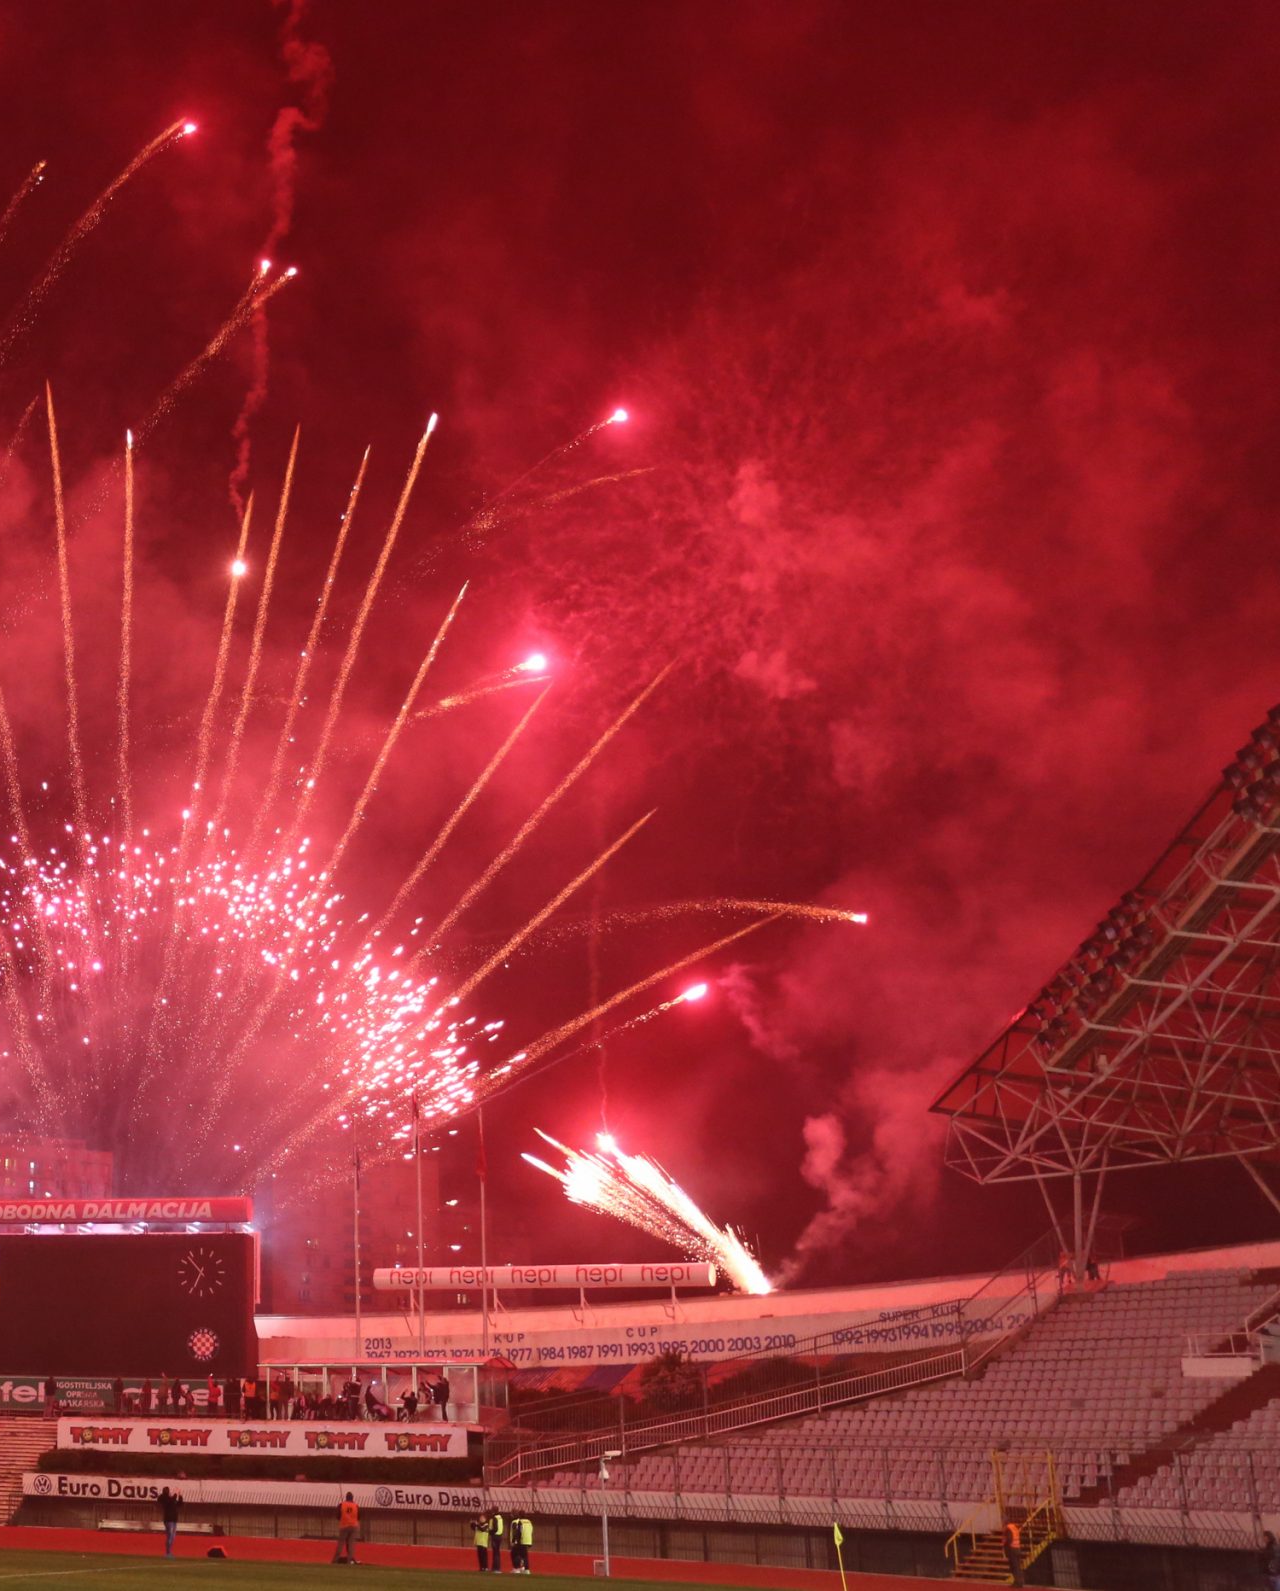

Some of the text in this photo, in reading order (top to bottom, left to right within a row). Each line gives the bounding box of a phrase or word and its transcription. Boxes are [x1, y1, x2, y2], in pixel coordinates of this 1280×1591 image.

[82, 1202, 213, 1219] DALMACIJA
[879, 1309, 921, 1323] SUPER
[493, 1333, 525, 1343] KUP
[626, 1327, 658, 1338] CUP
[831, 1330, 865, 1346] 1992
[866, 1327, 897, 1343] 1993
[898, 1324, 930, 1341] 1994
[931, 1321, 963, 1338] 1995
[365, 1338, 392, 1350] 2013
[506, 1347, 532, 1361] 1977
[536, 1346, 565, 1361] 1984
[567, 1345, 594, 1359] 1987
[597, 1343, 624, 1358] 1991
[626, 1342, 656, 1356] 1993
[691, 1338, 724, 1354] 2000
[727, 1336, 761, 1352] 2003
[764, 1334, 796, 1349] 2010
[70, 1426, 134, 1445] TOMMY
[147, 1428, 212, 1447] TOMMY
[227, 1429, 291, 1448] TOMMY
[304, 1431, 370, 1450] TOMMY
[384, 1433, 453, 1452] TOMMY
[58, 1476, 101, 1496] Euro
[107, 1479, 160, 1499] Daus
[395, 1490, 433, 1506] Euro
[438, 1491, 481, 1508] Daus
